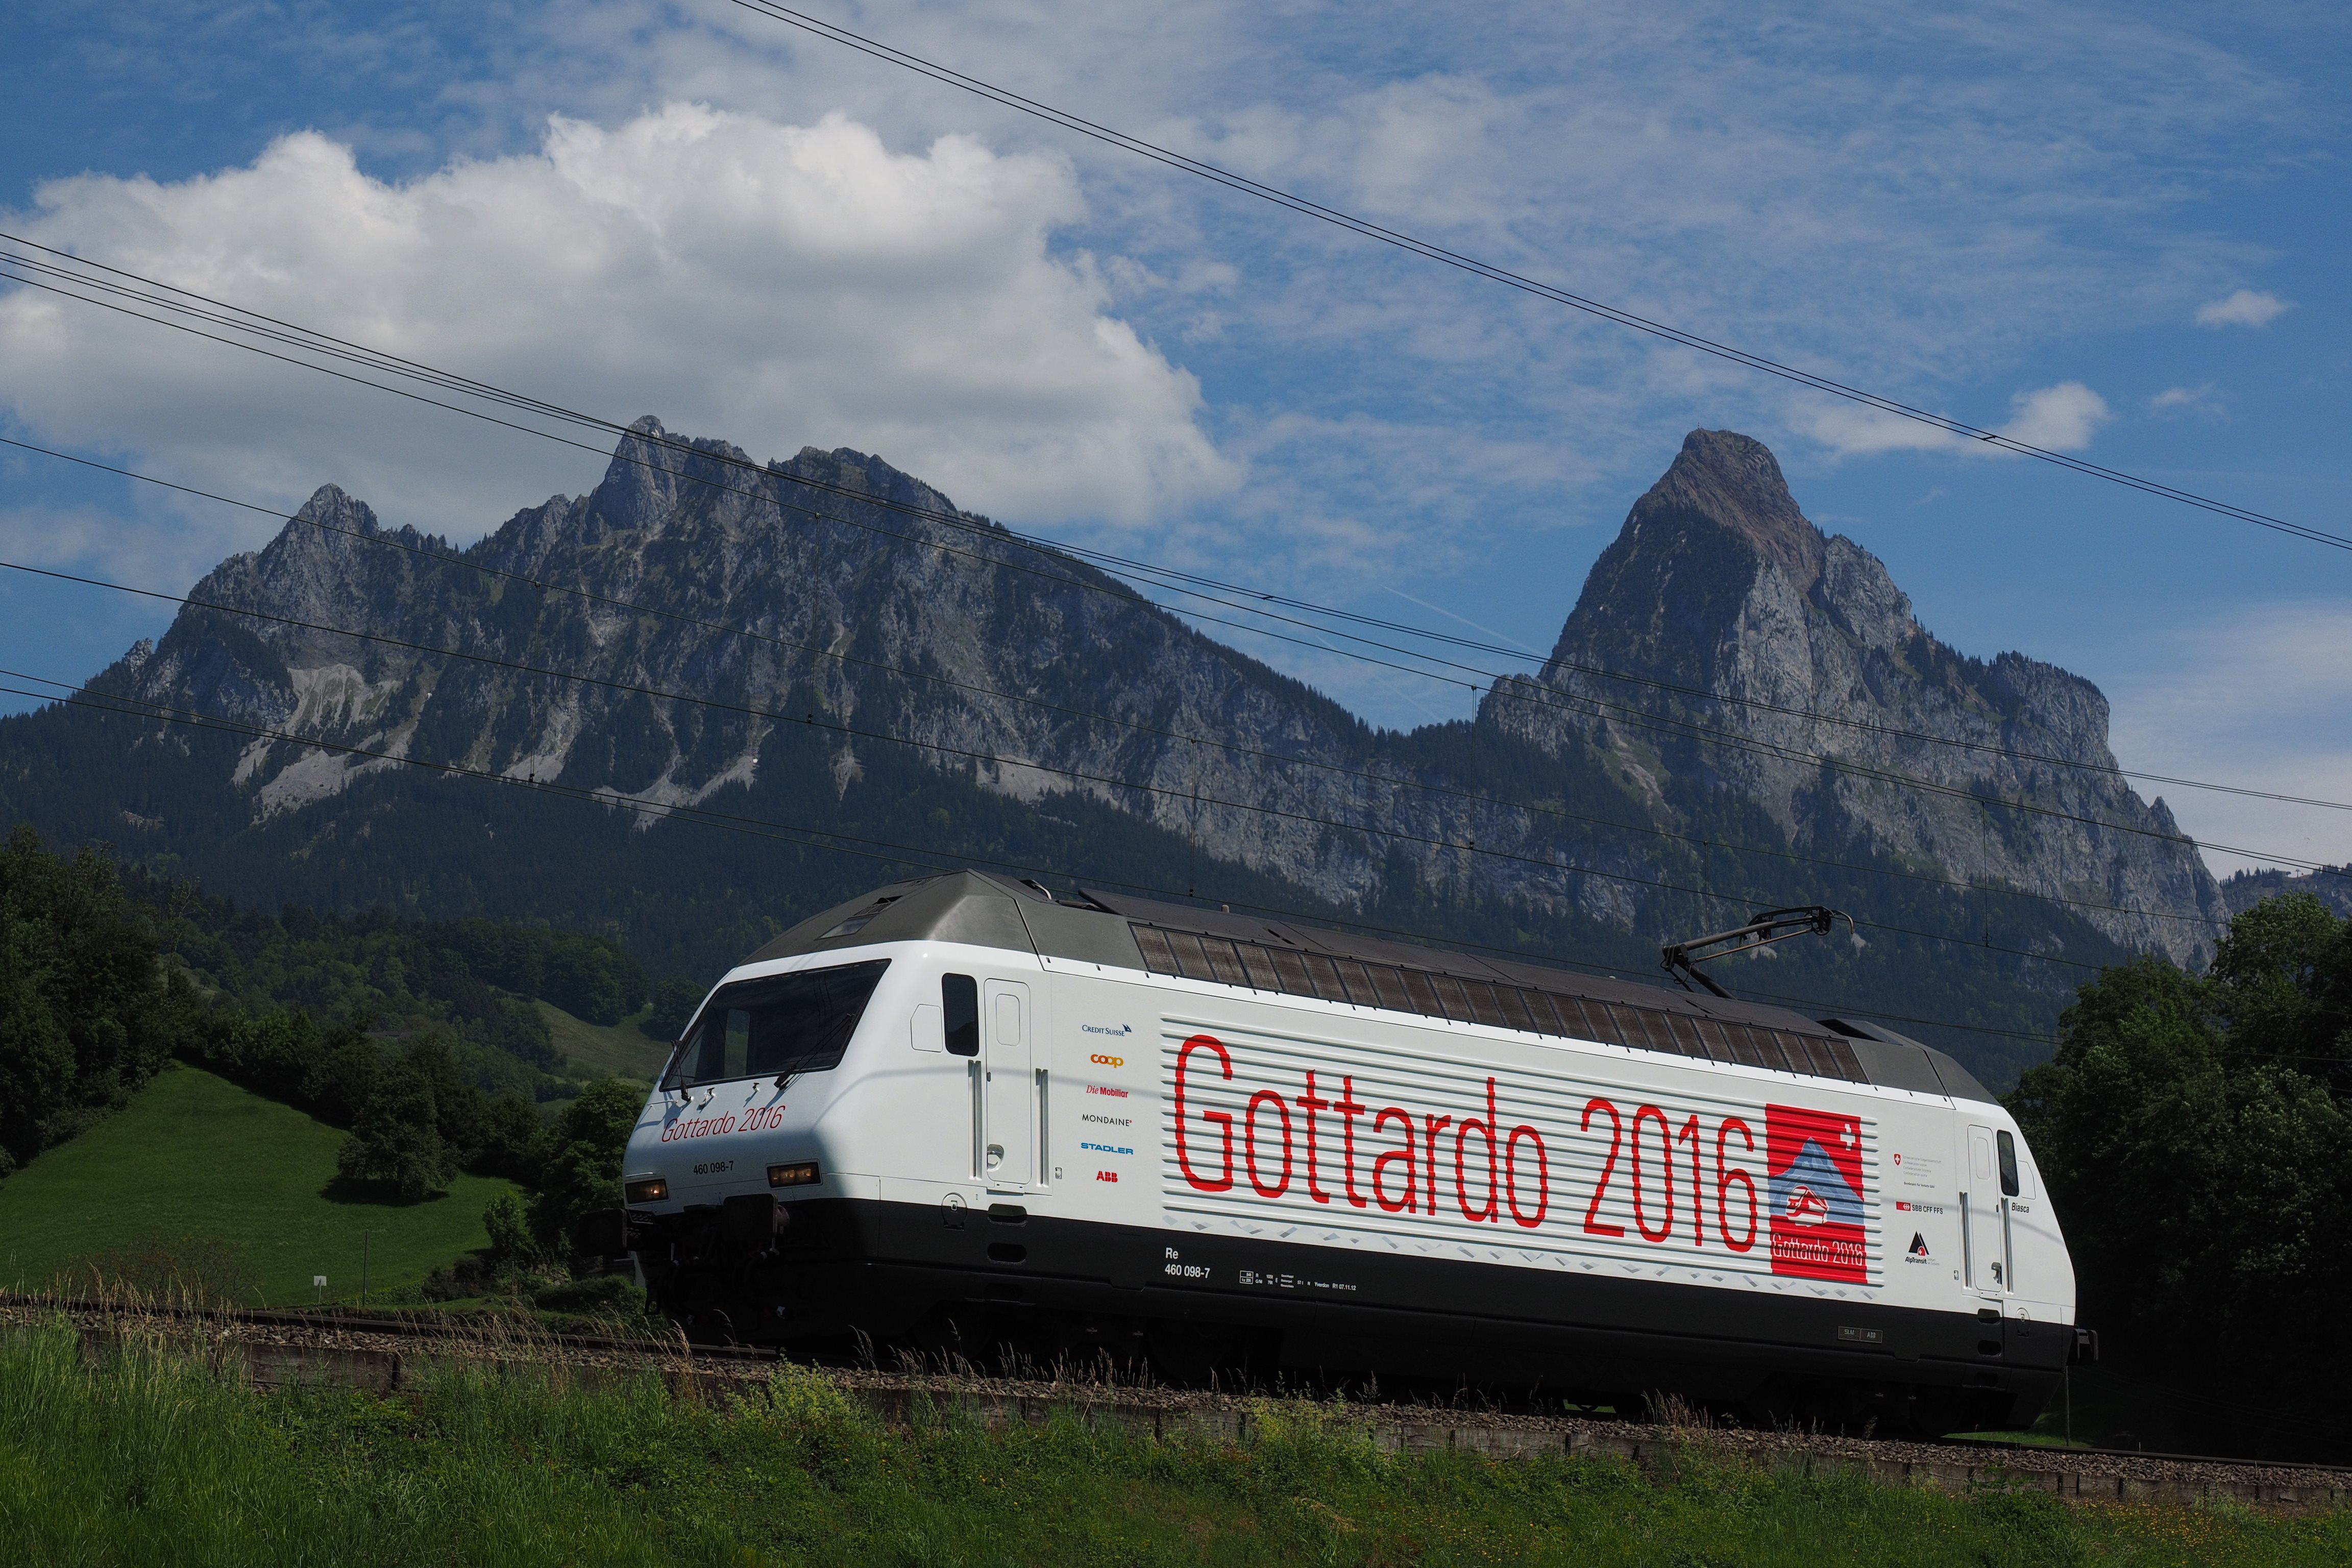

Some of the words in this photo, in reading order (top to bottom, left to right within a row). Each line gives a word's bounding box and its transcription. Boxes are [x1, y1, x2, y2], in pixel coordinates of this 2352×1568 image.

[1082, 1024, 1105, 1034] CREDIT
[1106, 1027, 1125, 1036] SUISSE
[1090, 1054, 1123, 1068] coop
[1086, 1085, 1098, 1094] Die
[1100, 1087, 1128, 1098] Mobiliar
[662, 1111, 735, 1142] Gottardo
[738, 1105, 786, 1132] 2016
[1082, 1114, 1130, 1126] MONDAINE
[1081, 1142, 1134, 1155] STADLER
[1174, 1034, 1548, 1229] Gottardo
[1580, 1098, 1757, 1253] 2016
[693, 1164, 708, 1174] 460
[710, 1161, 734, 1173] 098-7
[1096, 1170, 1118, 1183] ABB
[2012, 1202, 2029, 1213] Biasca
[1165, 1247, 1179, 1260] Re
[1772, 1233, 1829, 1262] Gottardo
[1832, 1240, 1863, 1266] 2016
[1905, 1256, 1927, 1264] AlpTransit
[1165, 1263, 1182, 1276] 460
[1184, 1265, 1211, 1279] 098-7
